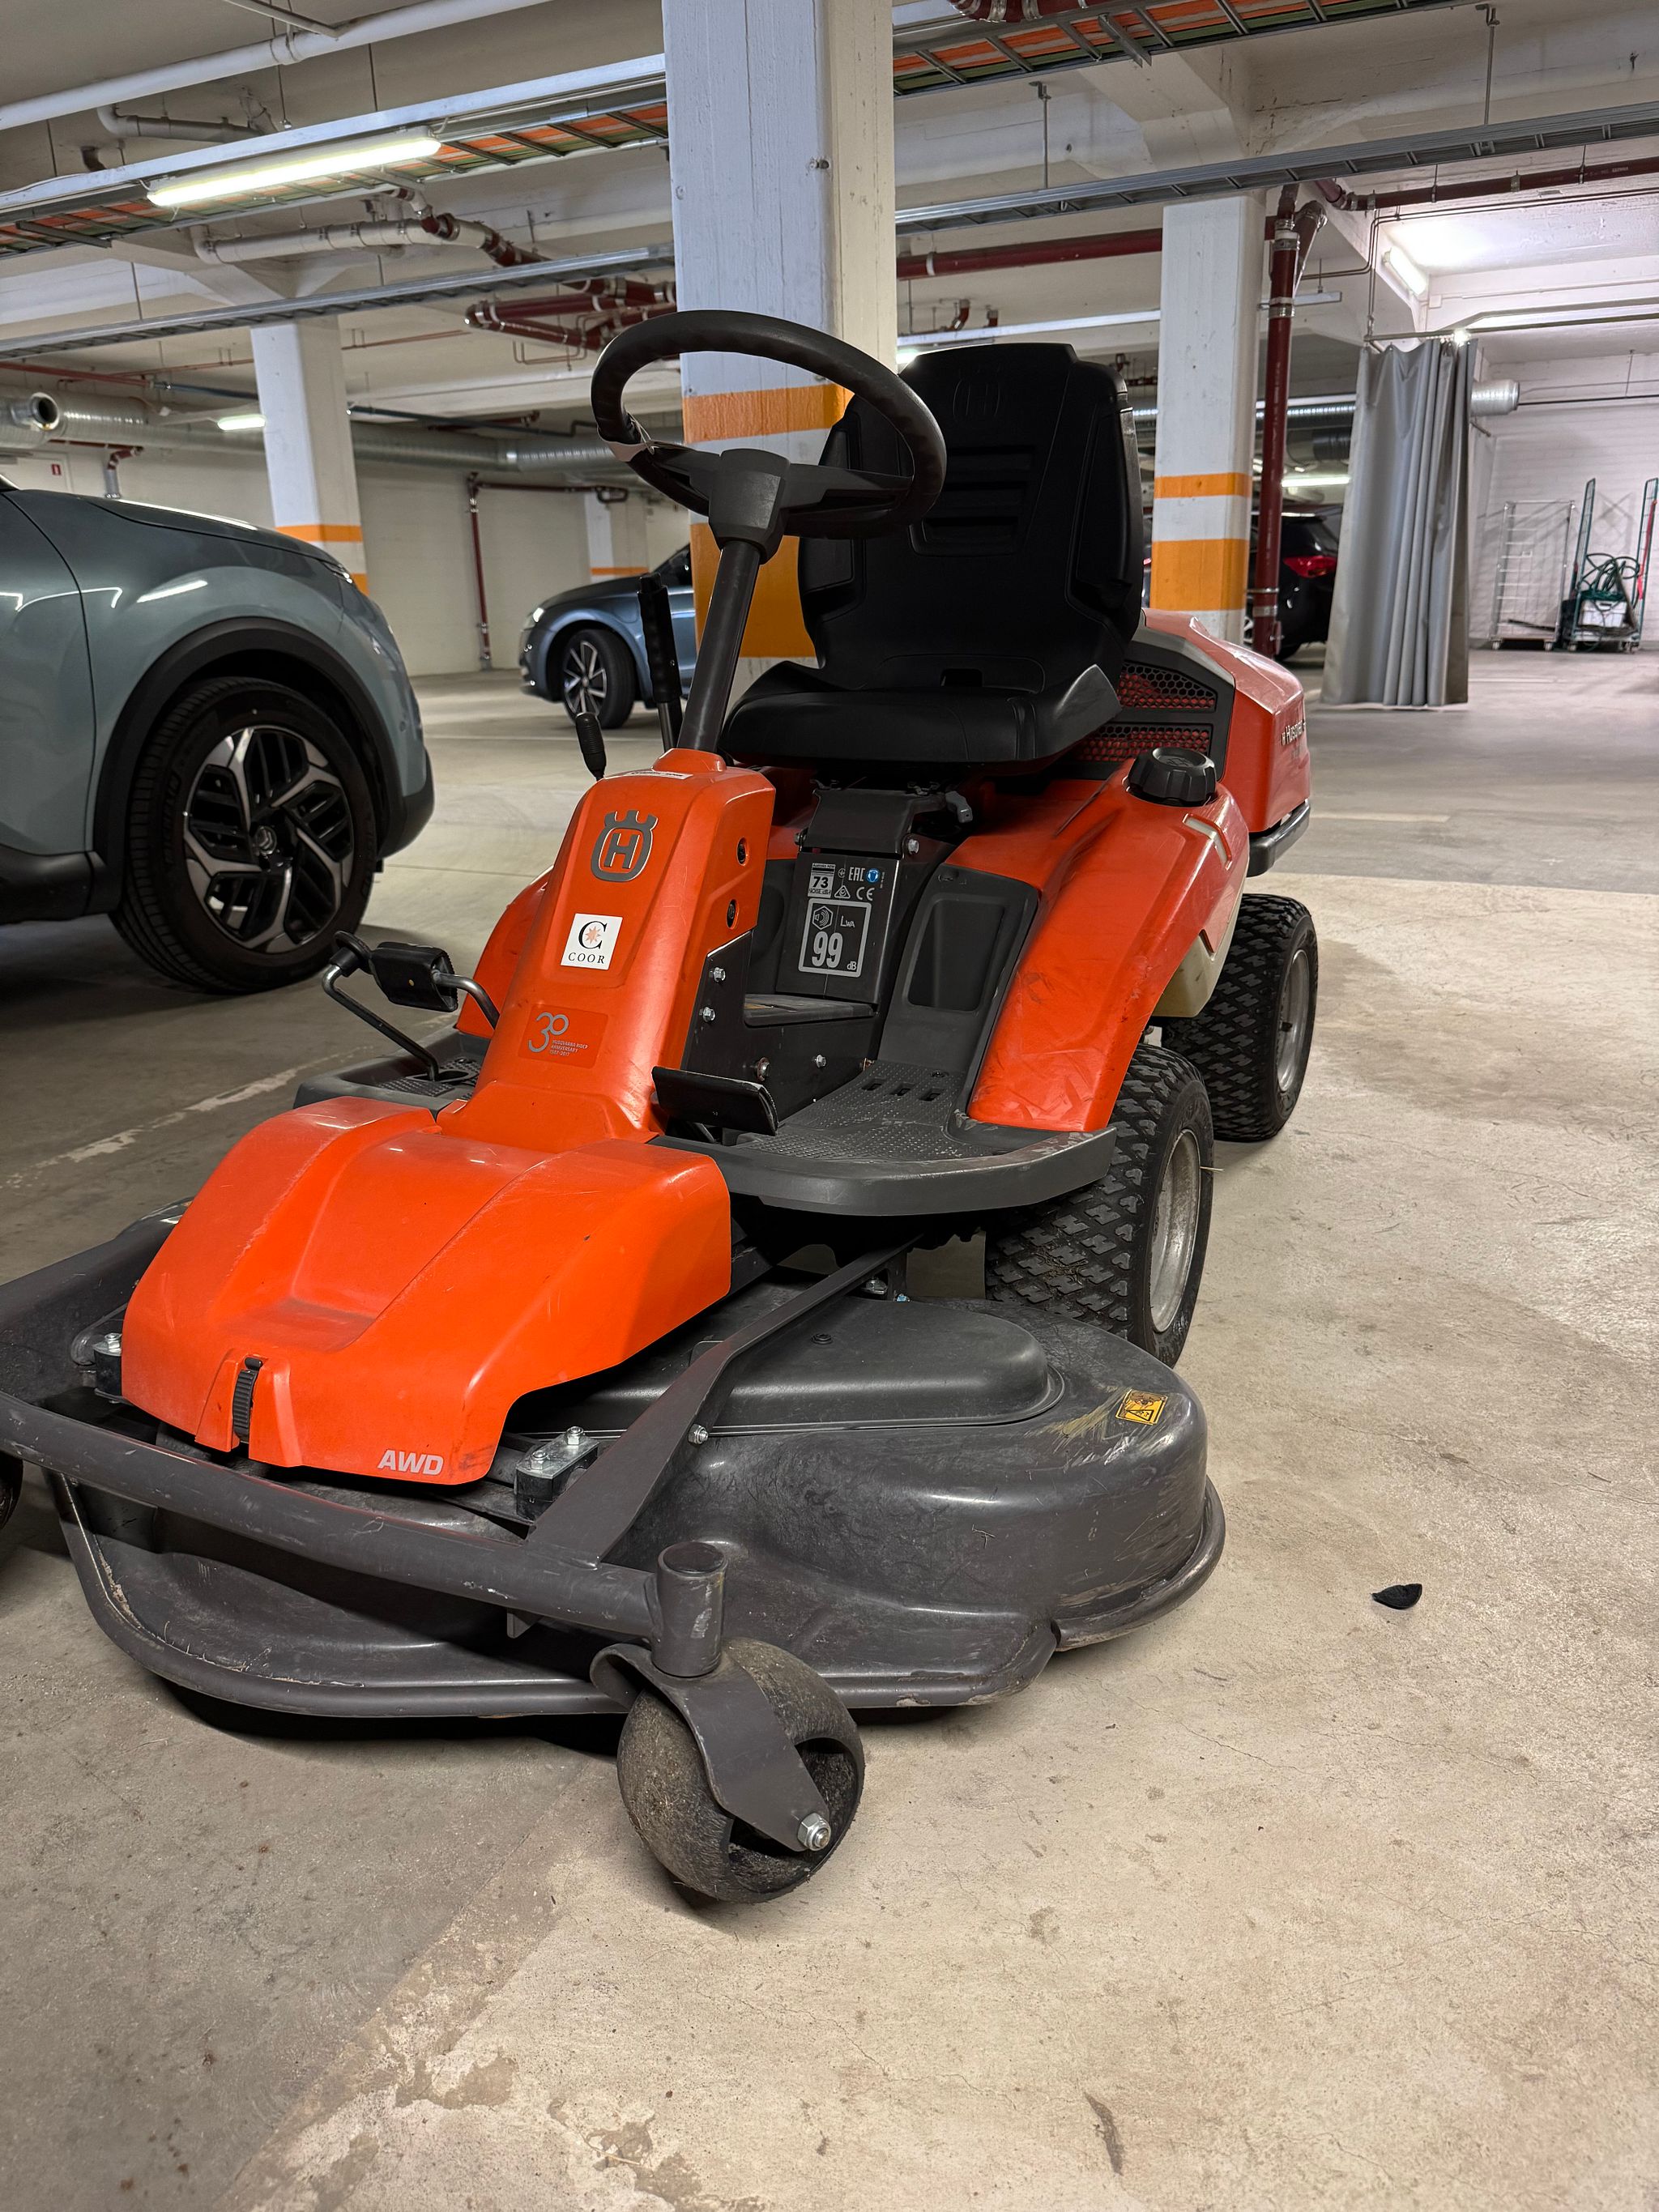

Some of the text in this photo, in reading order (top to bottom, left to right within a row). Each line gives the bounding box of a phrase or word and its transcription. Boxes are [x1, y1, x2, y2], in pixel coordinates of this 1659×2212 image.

[848, 867, 866, 882] EAC
[812, 876, 829, 889] 73
[856, 886, 875, 901] CE
[812, 931, 843, 968] 99
[568, 952, 605, 964] COOR
[847, 961, 857, 970] dB
[528, 1012, 569, 1052] 30
[377, 1449, 445, 1476] AWD
